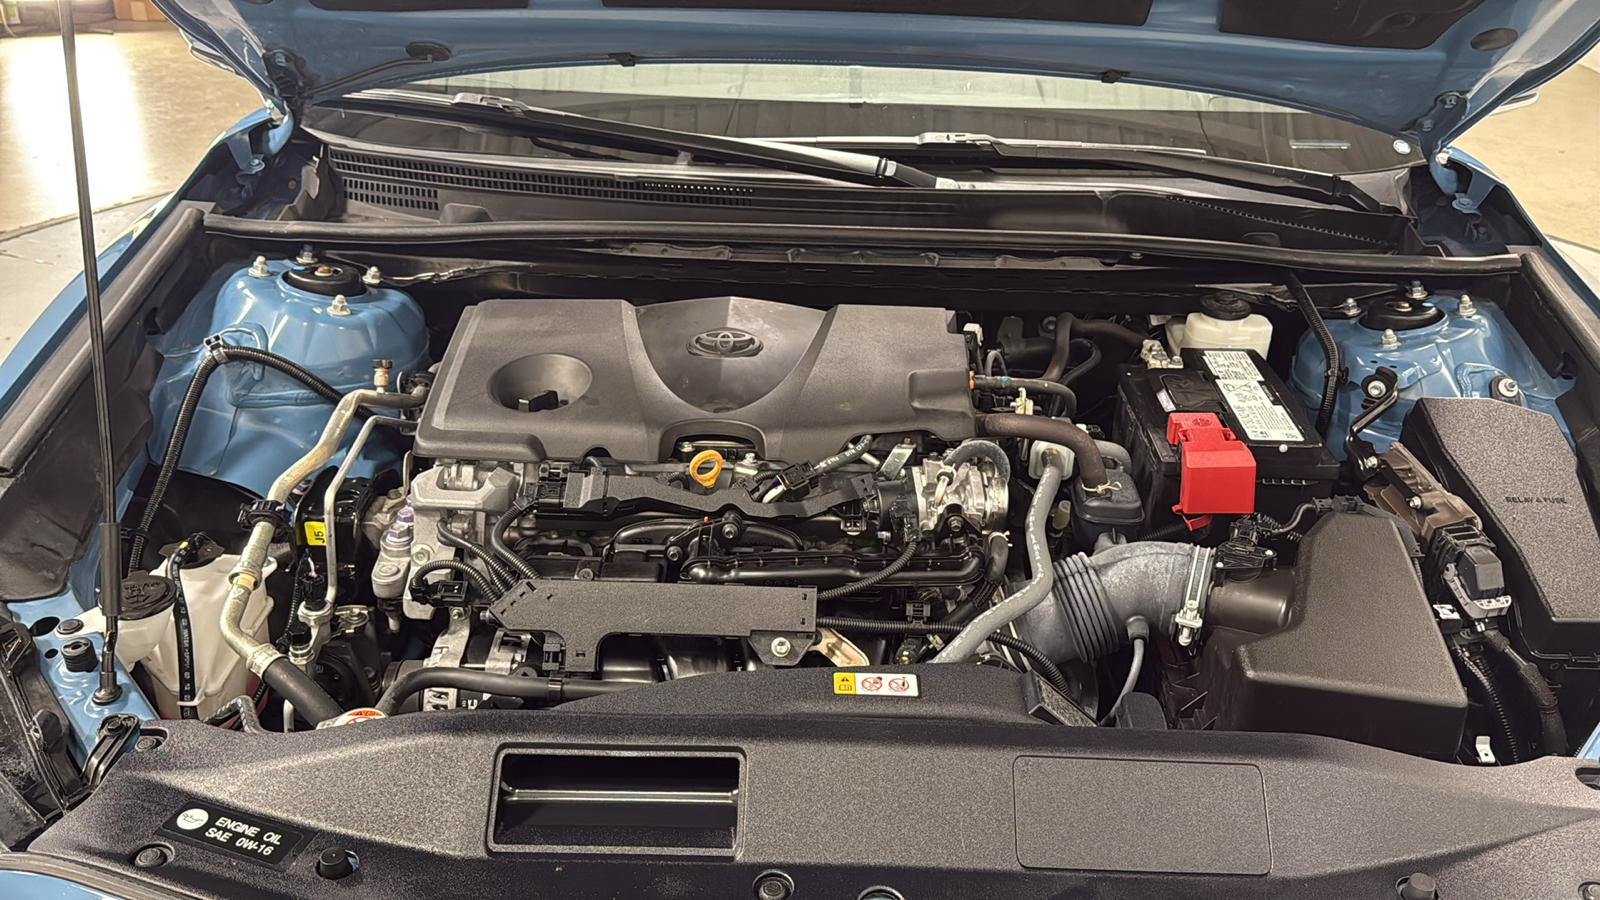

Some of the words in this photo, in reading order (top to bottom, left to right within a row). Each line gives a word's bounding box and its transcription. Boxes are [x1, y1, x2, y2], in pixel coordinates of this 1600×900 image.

[314, 530, 325, 544] J5
[205, 828, 233, 842] SAE
[235, 837, 274, 856] 0W-16
[215, 816, 260, 837] ENGINE
[263, 832, 282, 845] OIL
